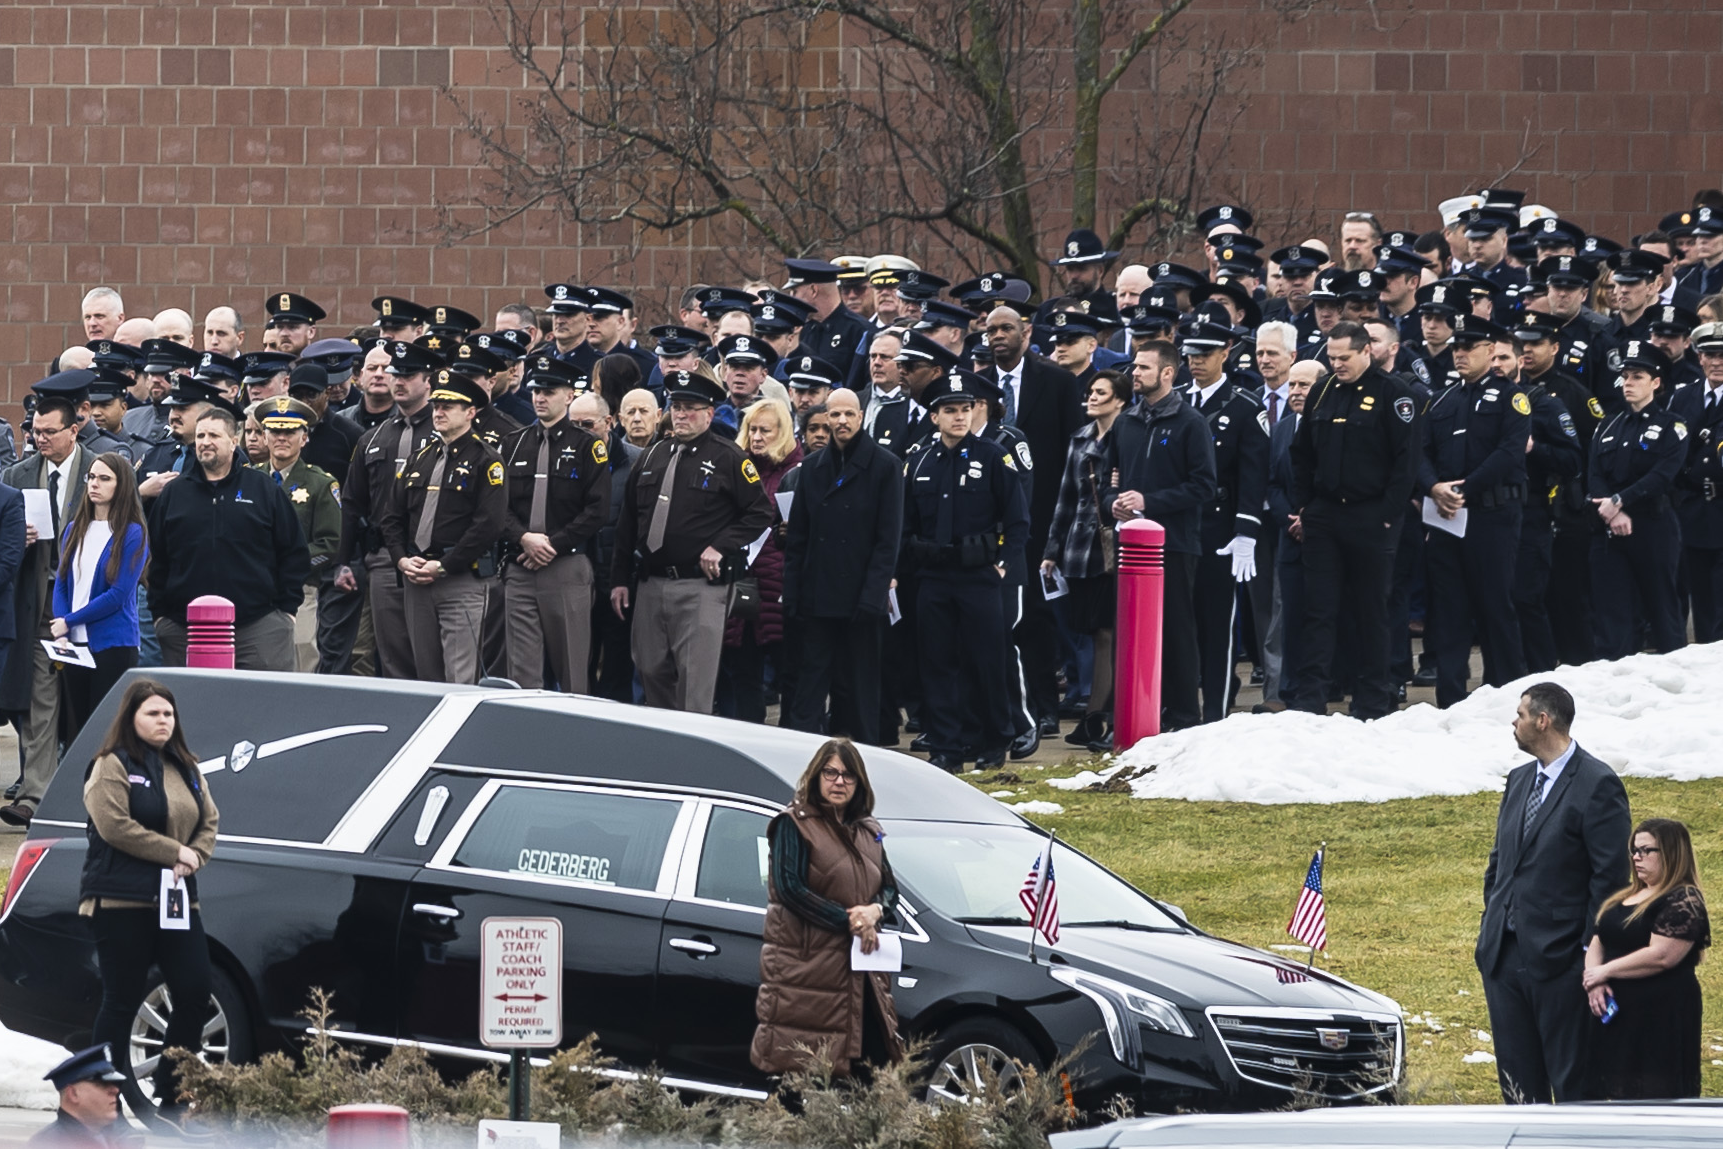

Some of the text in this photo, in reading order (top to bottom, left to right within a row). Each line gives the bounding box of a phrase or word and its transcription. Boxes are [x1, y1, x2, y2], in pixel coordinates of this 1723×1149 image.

[518, 849, 610, 881] CEDERBERG
[496, 929, 548, 939] ATHLETIC
[502, 941, 540, 952] STAFF/
[502, 954, 542, 964] COACH
[496, 966, 546, 977] PARKING
[506, 979, 536, 990] ONLY
[504, 1005, 537, 1014] PERMIT
[498, 1017, 543, 1026] REQUIRED
